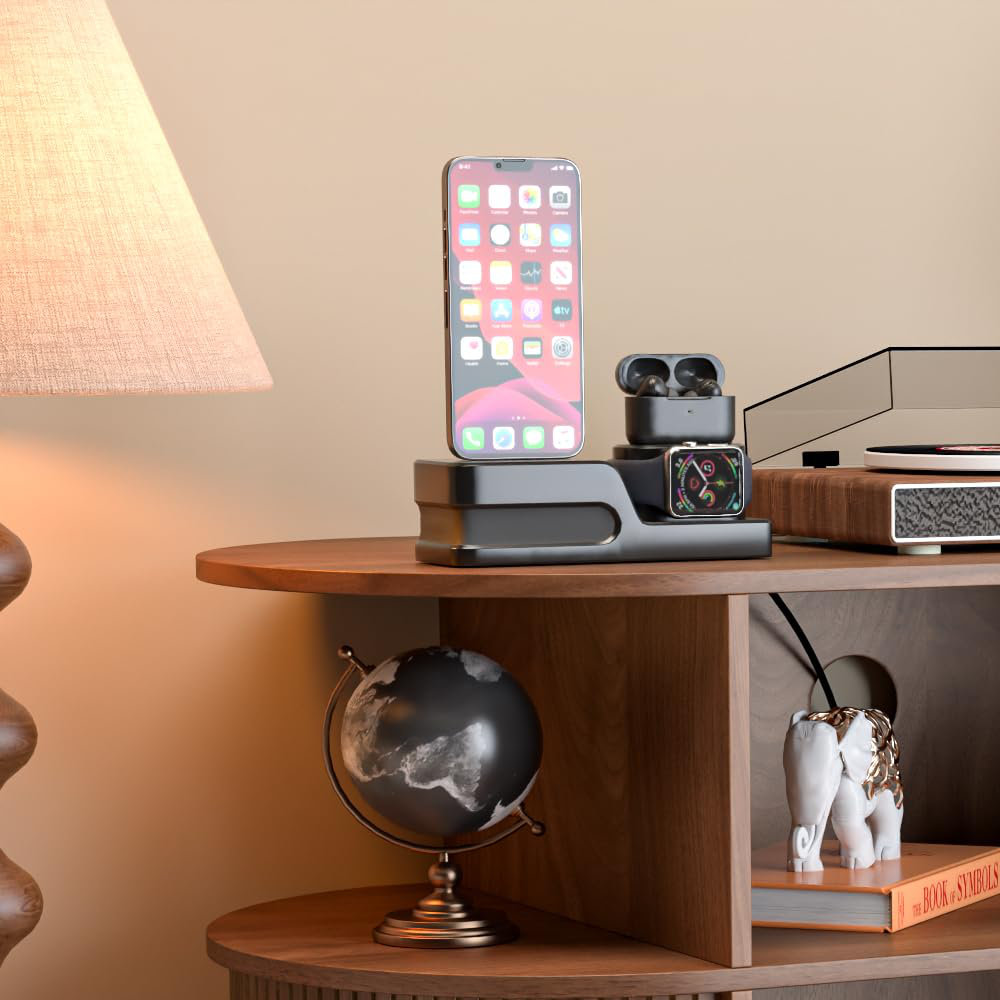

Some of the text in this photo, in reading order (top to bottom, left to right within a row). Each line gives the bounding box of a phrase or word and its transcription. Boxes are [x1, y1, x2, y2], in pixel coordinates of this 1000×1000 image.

[912, 902, 922, 917] THE
[923, 879, 949, 914] BOOK
[957, 862, 999, 901] SYMBOLS
